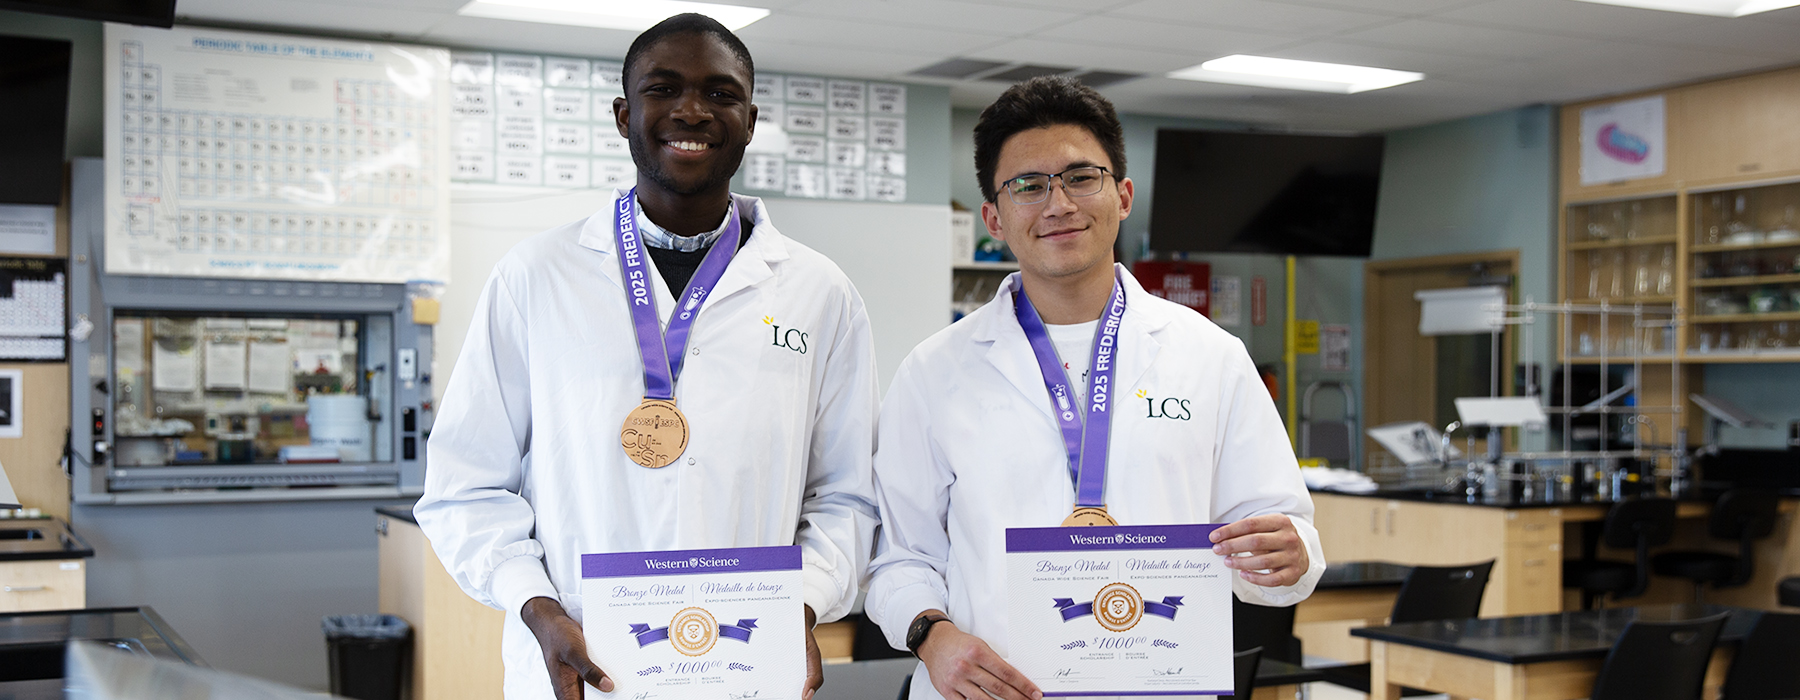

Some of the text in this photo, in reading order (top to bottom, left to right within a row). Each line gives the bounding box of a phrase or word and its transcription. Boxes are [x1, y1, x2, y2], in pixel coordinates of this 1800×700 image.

[630, 270, 649, 306] 2025
[1163, 274, 1192, 289] FIRE
[772, 324, 809, 354] LCS
[1092, 375, 1108, 412] 2025
[1146, 397, 1191, 421] LCS
[1070, 533, 1167, 545] Western Science
[645, 556, 740, 570] Western Science
[1036, 559, 1111, 575] Bronze Medal
[1125, 558, 1211, 572] Médaille de bronze
[611, 583, 686, 601] Bronze Medal
[700, 581, 783, 596] Médaille de bronze
